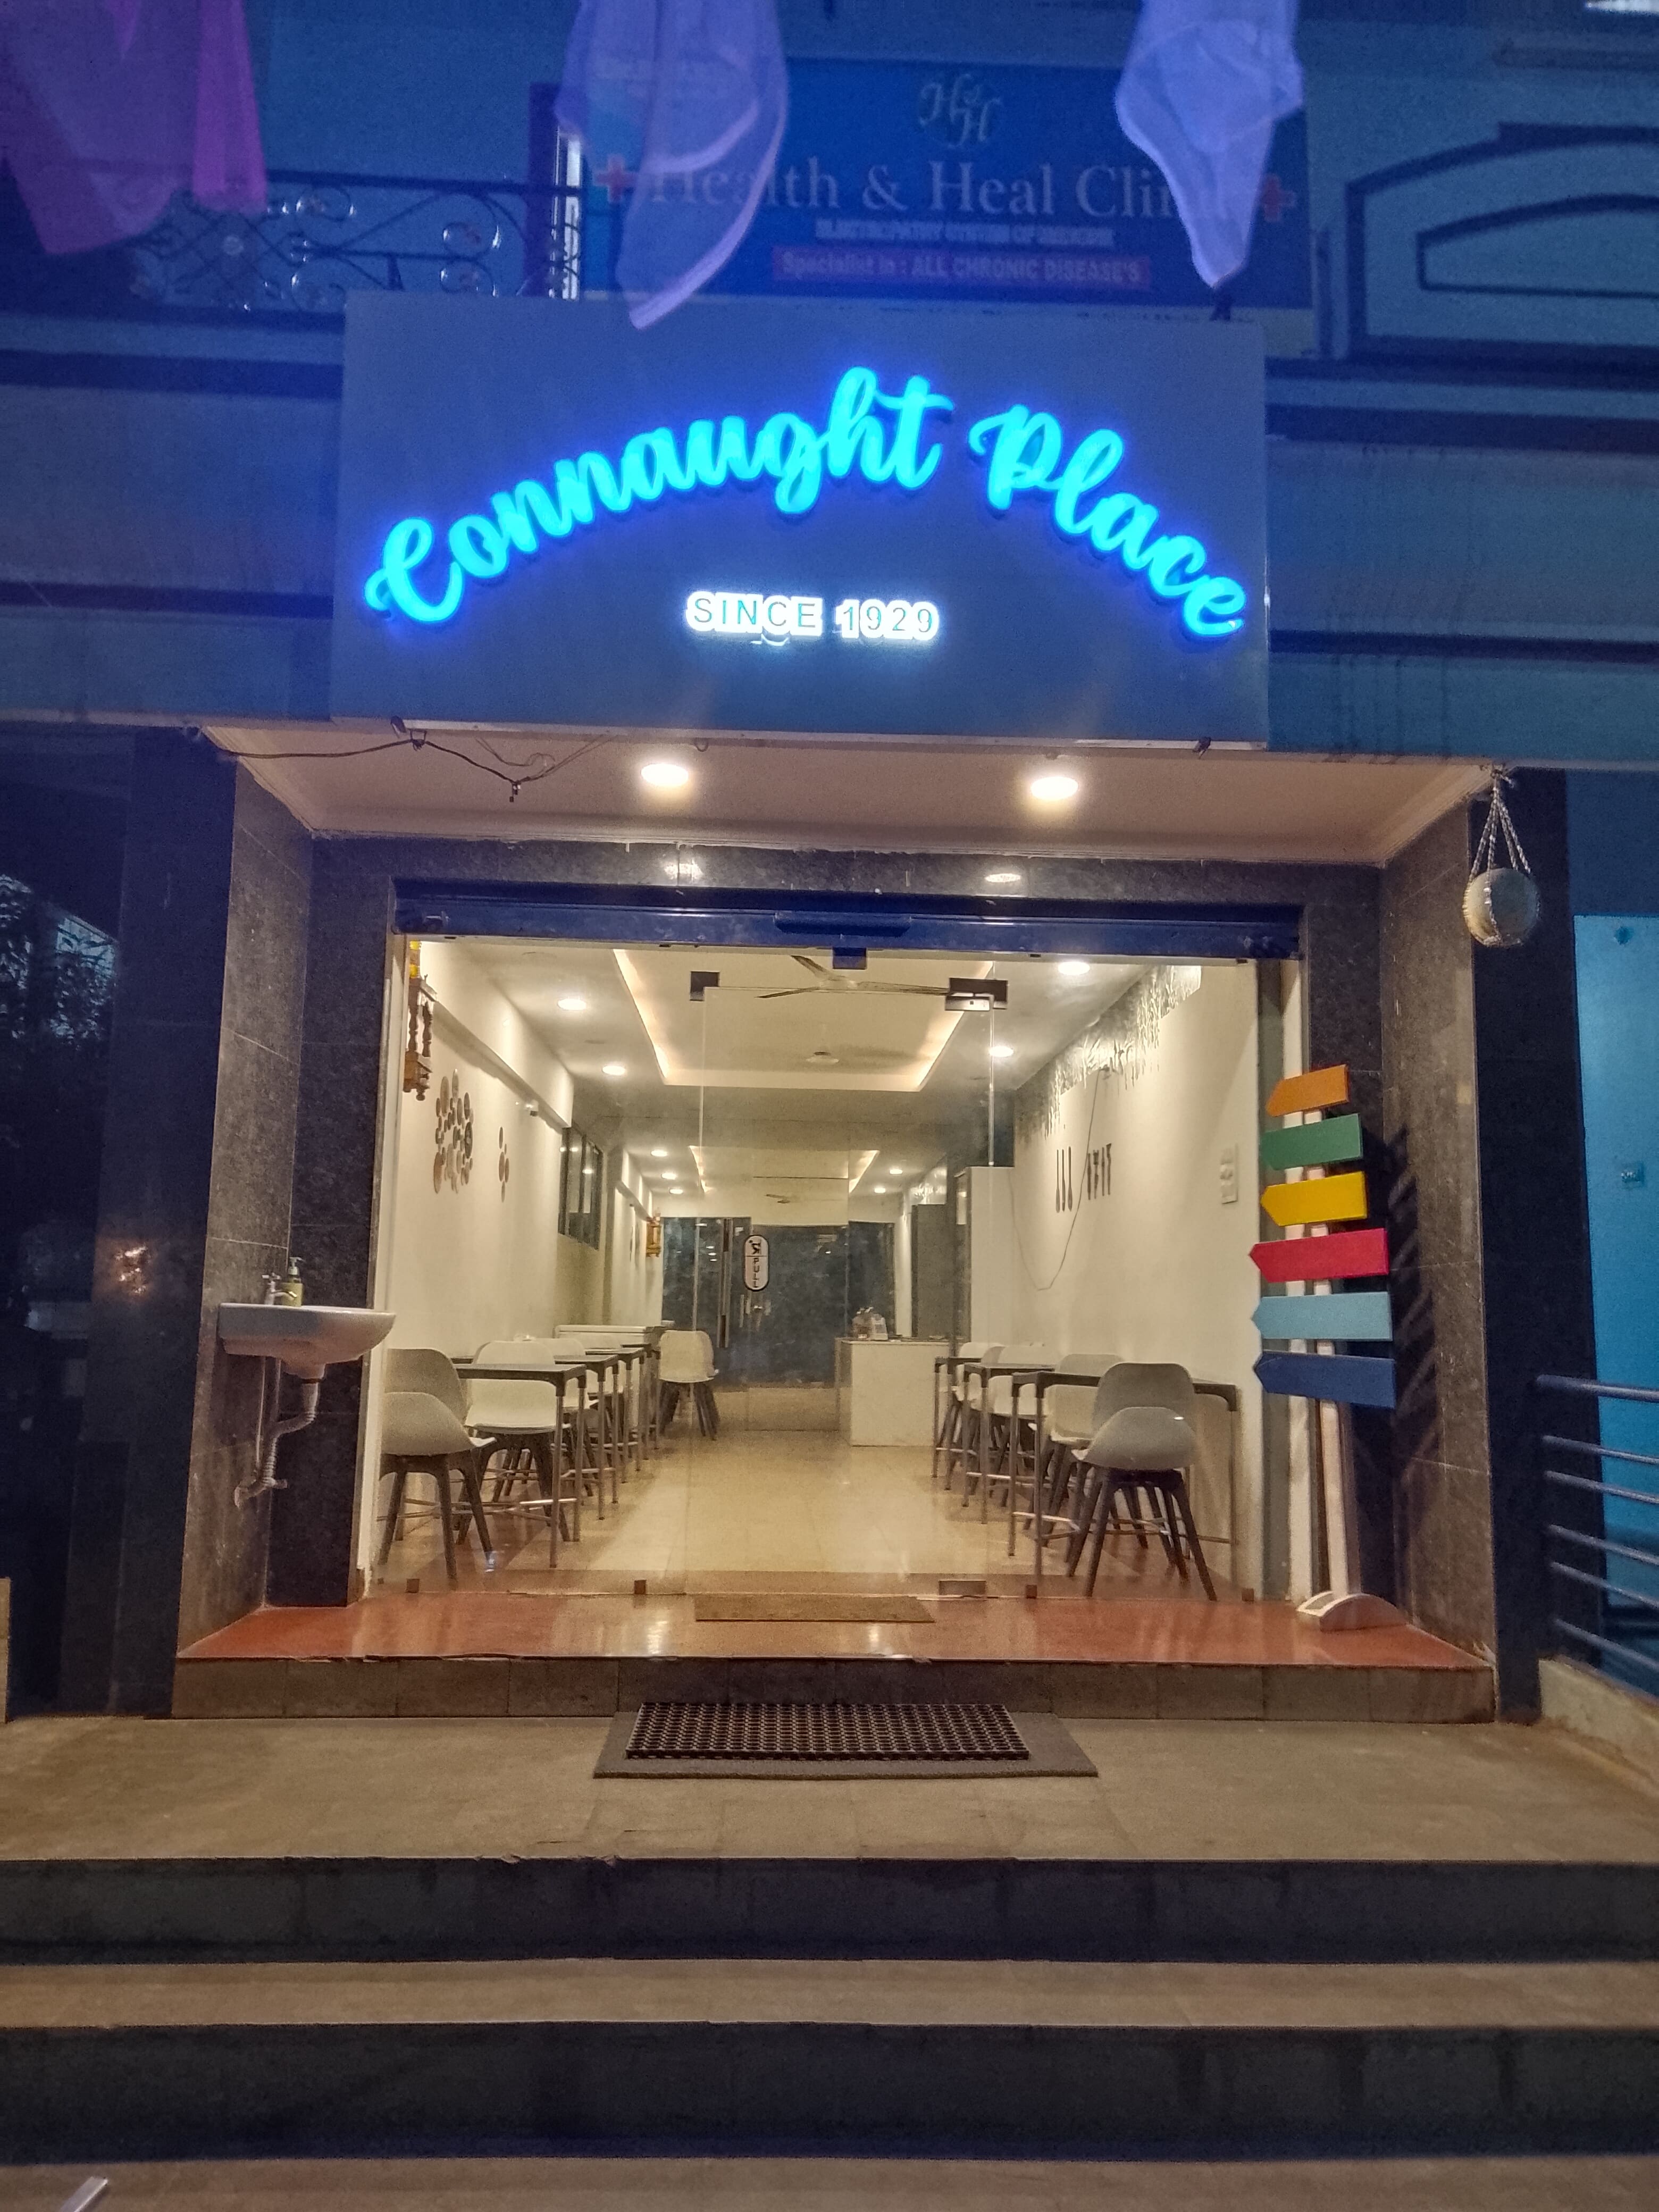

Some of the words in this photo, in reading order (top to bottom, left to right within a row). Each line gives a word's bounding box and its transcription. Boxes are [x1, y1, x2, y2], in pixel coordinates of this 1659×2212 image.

[861, 163, 908, 212] &
[928, 158, 1055, 217] Heal
[911, 255, 948, 278] ALL
[952, 255, 1038, 280] CHRONIC
[364, 365, 955, 626] Connaught
[968, 402, 1249, 641] Place
[690, 594, 820, 633] SINCE
[839, 601, 936, 637] 1929
